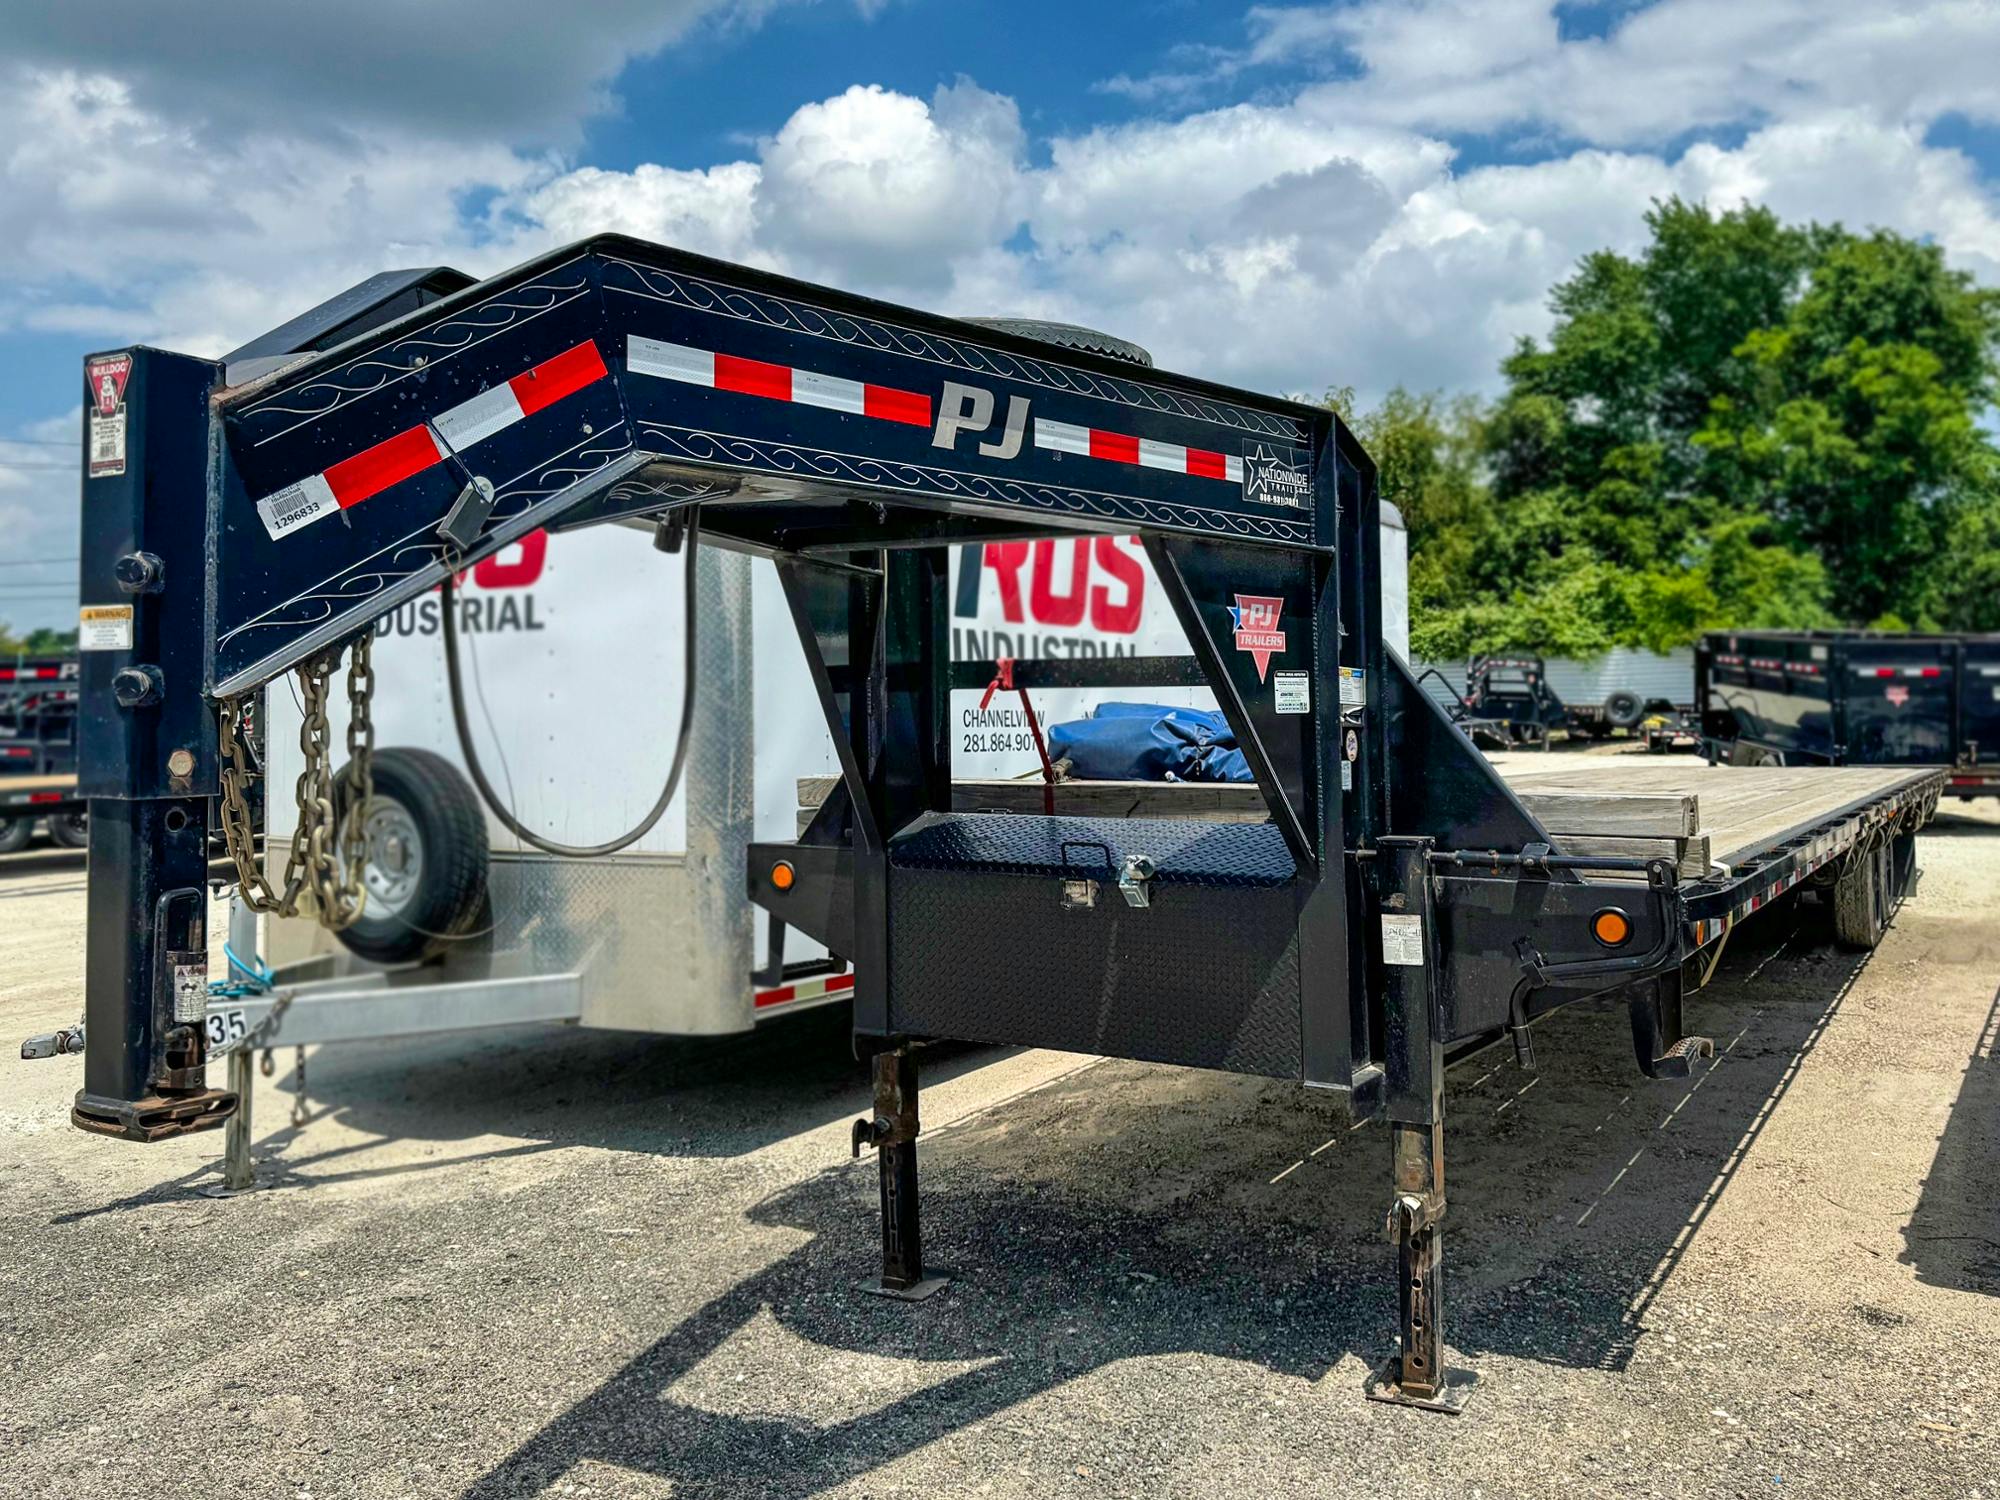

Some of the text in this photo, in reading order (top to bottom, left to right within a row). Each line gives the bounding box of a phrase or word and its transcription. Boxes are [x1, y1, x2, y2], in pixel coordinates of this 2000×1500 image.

[93, 361, 126, 377] BULLDOG
[931, 380, 1031, 460] PJ
[1258, 466, 1308, 485] NATIONWIDE
[273, 502, 321, 530] 1296833
[375, 595, 545, 638] DUSRIAL
[1249, 603, 1274, 627] PJ
[1240, 634, 1283, 647] TRAILERS
[60, 662, 79, 679] P
[963, 709, 1045, 728] CHANNELVIW
[963, 732, 1044, 753] 281.864.907
